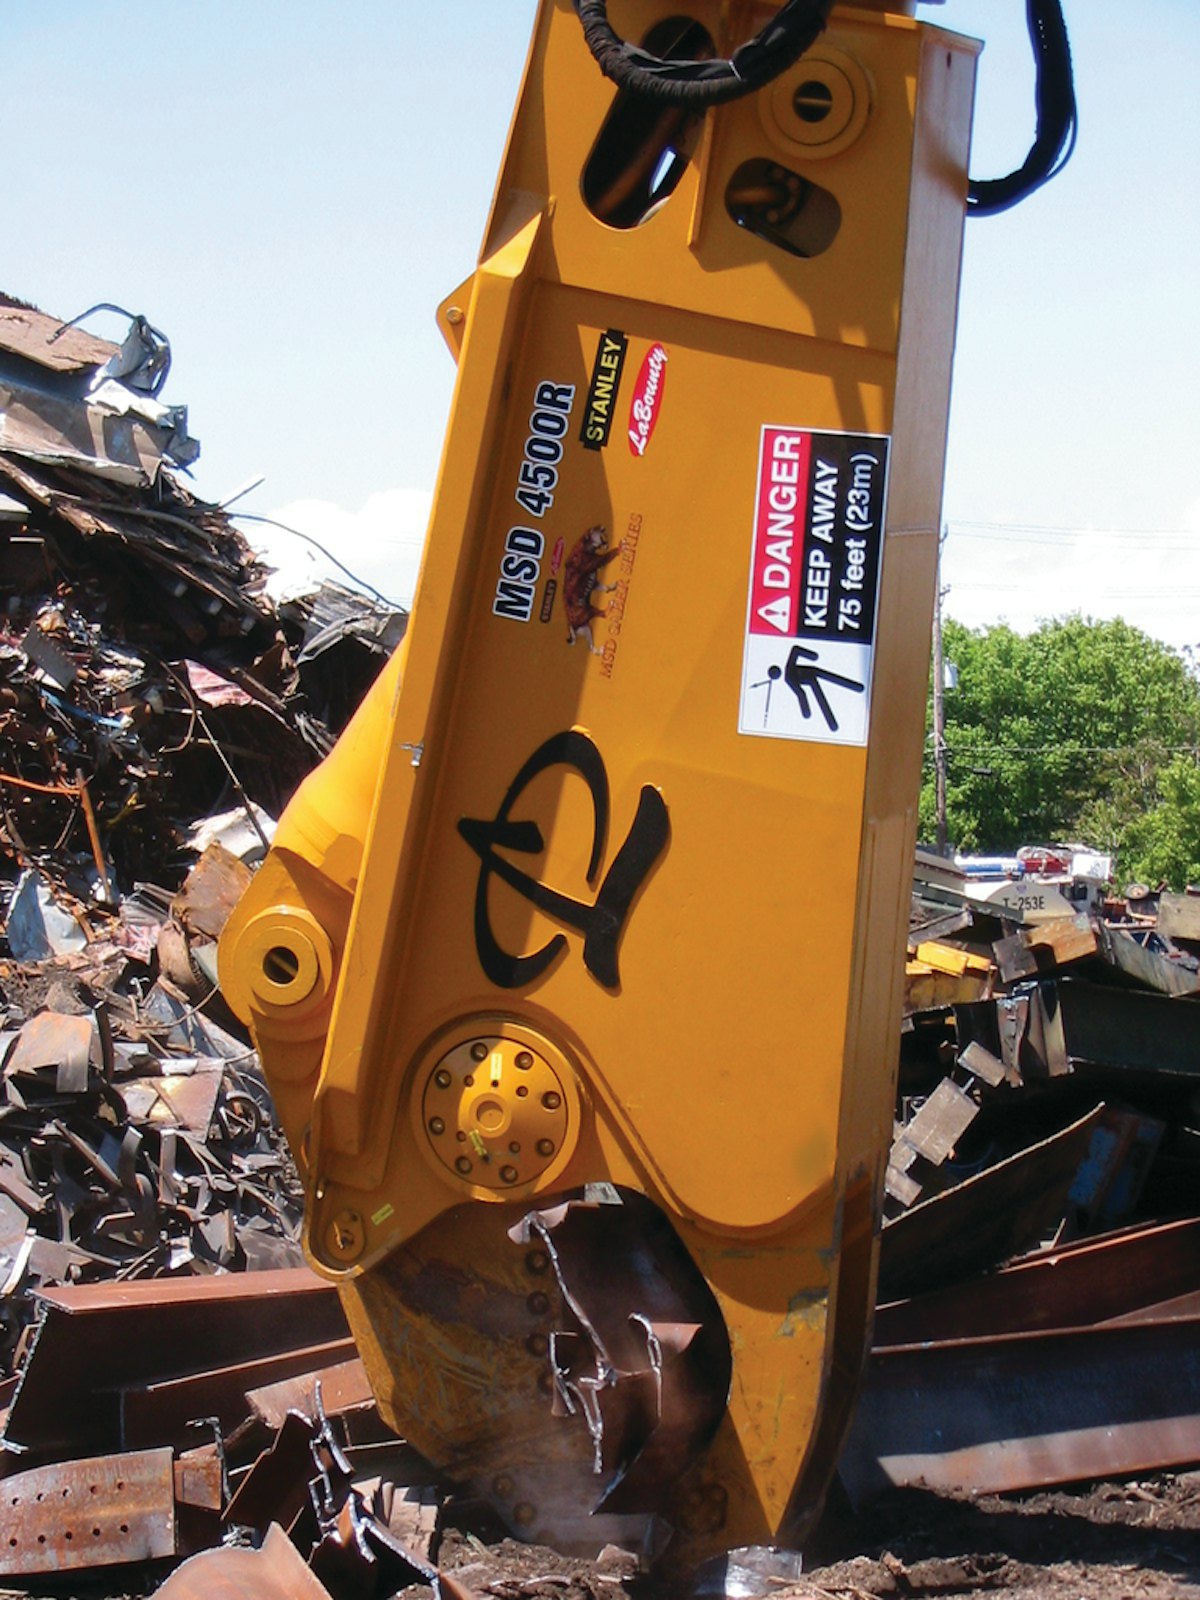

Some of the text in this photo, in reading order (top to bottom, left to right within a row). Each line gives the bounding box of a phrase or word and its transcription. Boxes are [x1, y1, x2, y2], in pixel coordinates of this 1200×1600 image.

[587, 338, 622, 442] STANLEY
[628, 346, 668, 456] LaBounty
[493, 380, 576, 622] MSD 4500R
[763, 435, 801, 589] DANGER
[804, 460, 839, 628] KEEP AWAY
[837, 453, 879, 631] 75 feet (23m)
[600, 638, 617, 679] MSD
[621, 512, 643, 575] SERIES
[1003, 896, 1045, 911] T-253E
